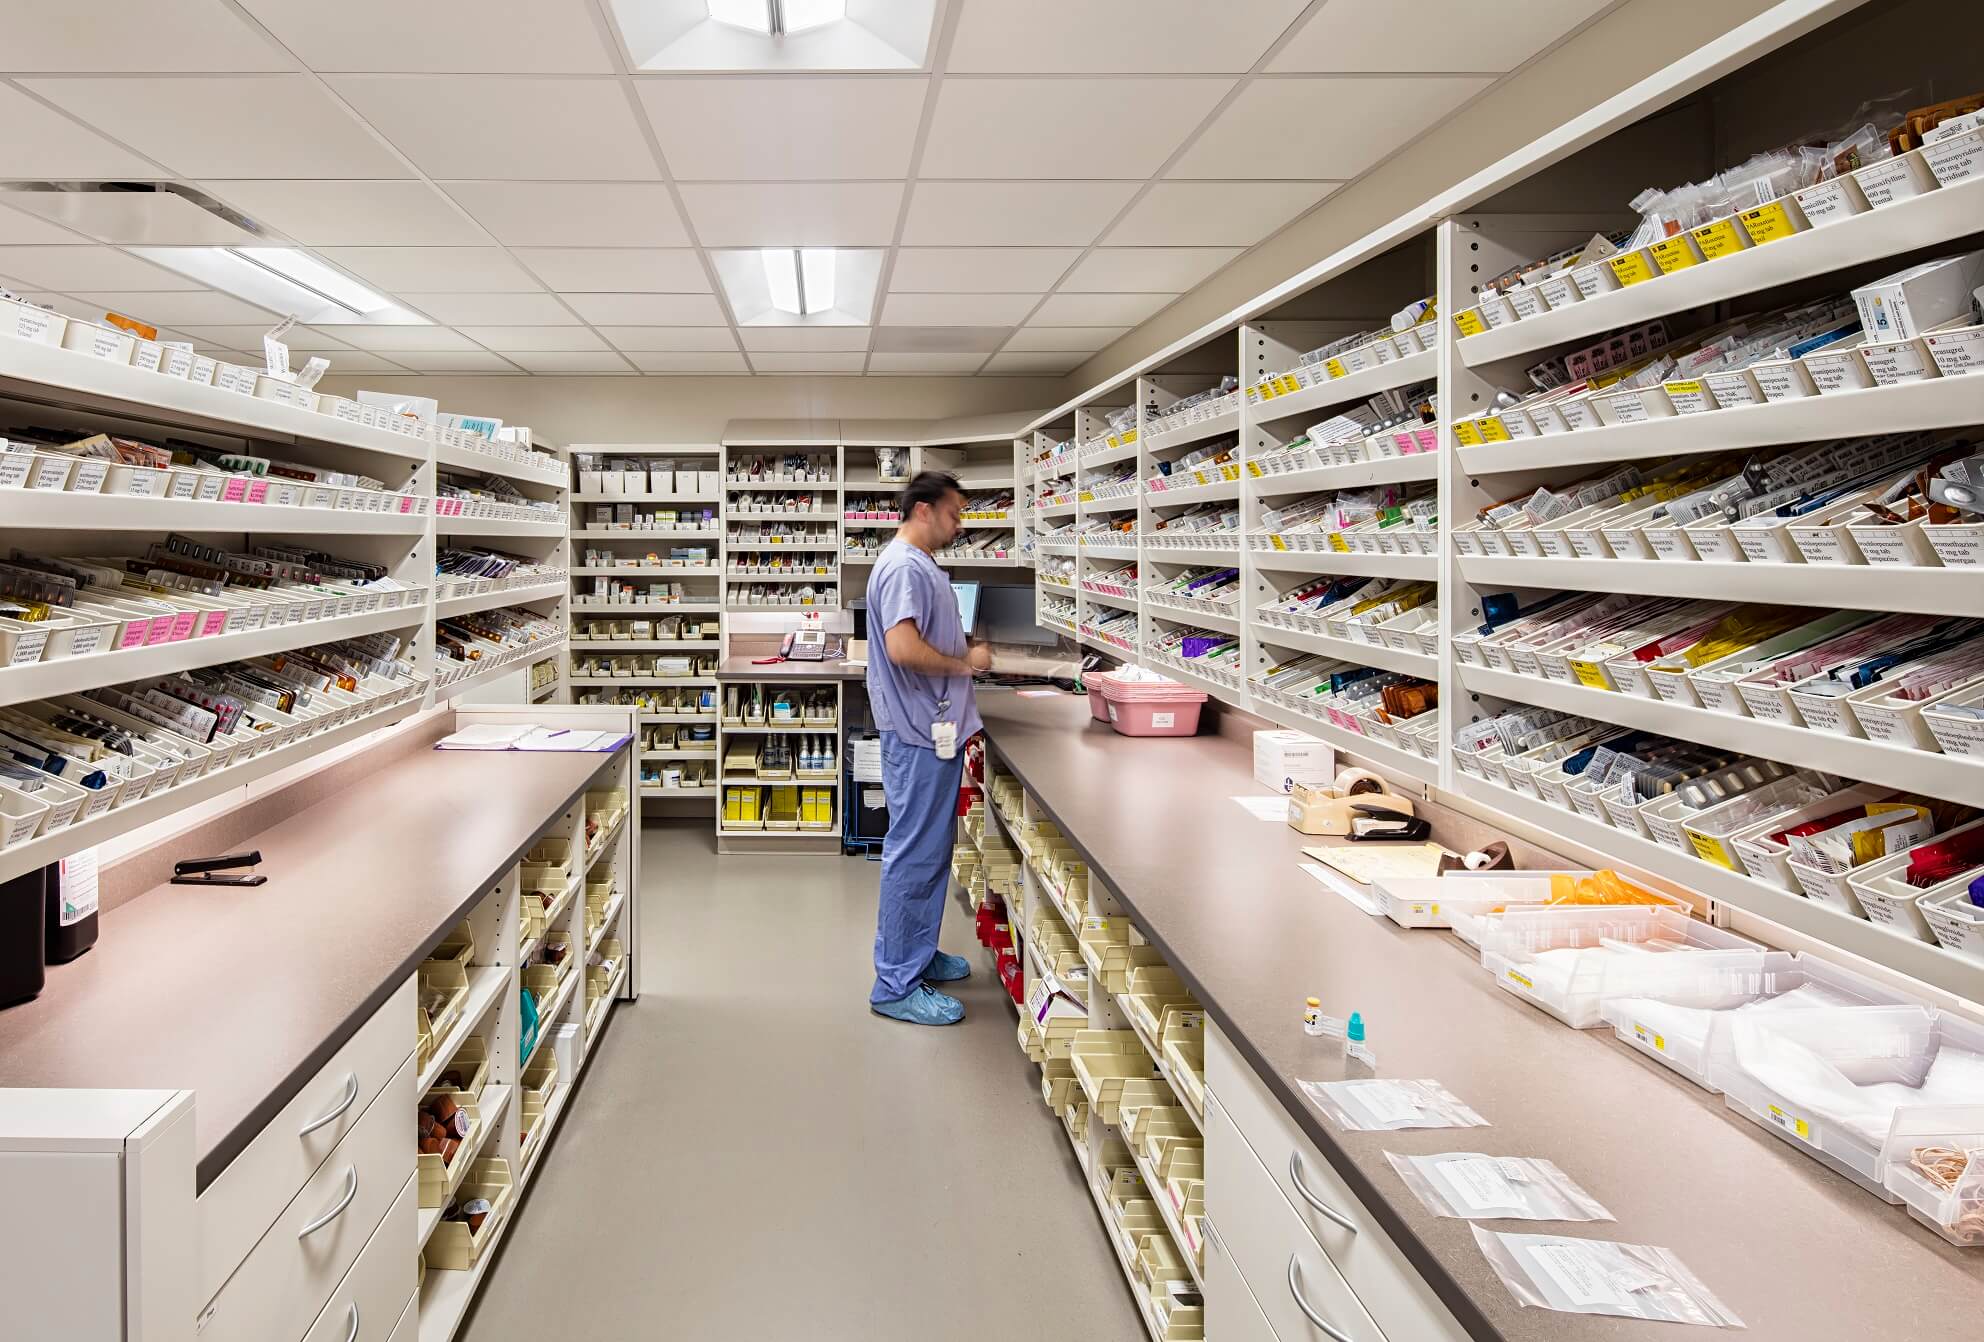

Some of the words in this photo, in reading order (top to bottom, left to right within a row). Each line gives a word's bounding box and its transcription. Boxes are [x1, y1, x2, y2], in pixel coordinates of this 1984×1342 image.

[1947, 164, 1958, 174] mg
[1959, 158, 1972, 168] tab
[1880, 188, 1890, 198] mg
[1802, 199, 1827, 211] enicillin
[1812, 366, 1844, 376] ramipexole
